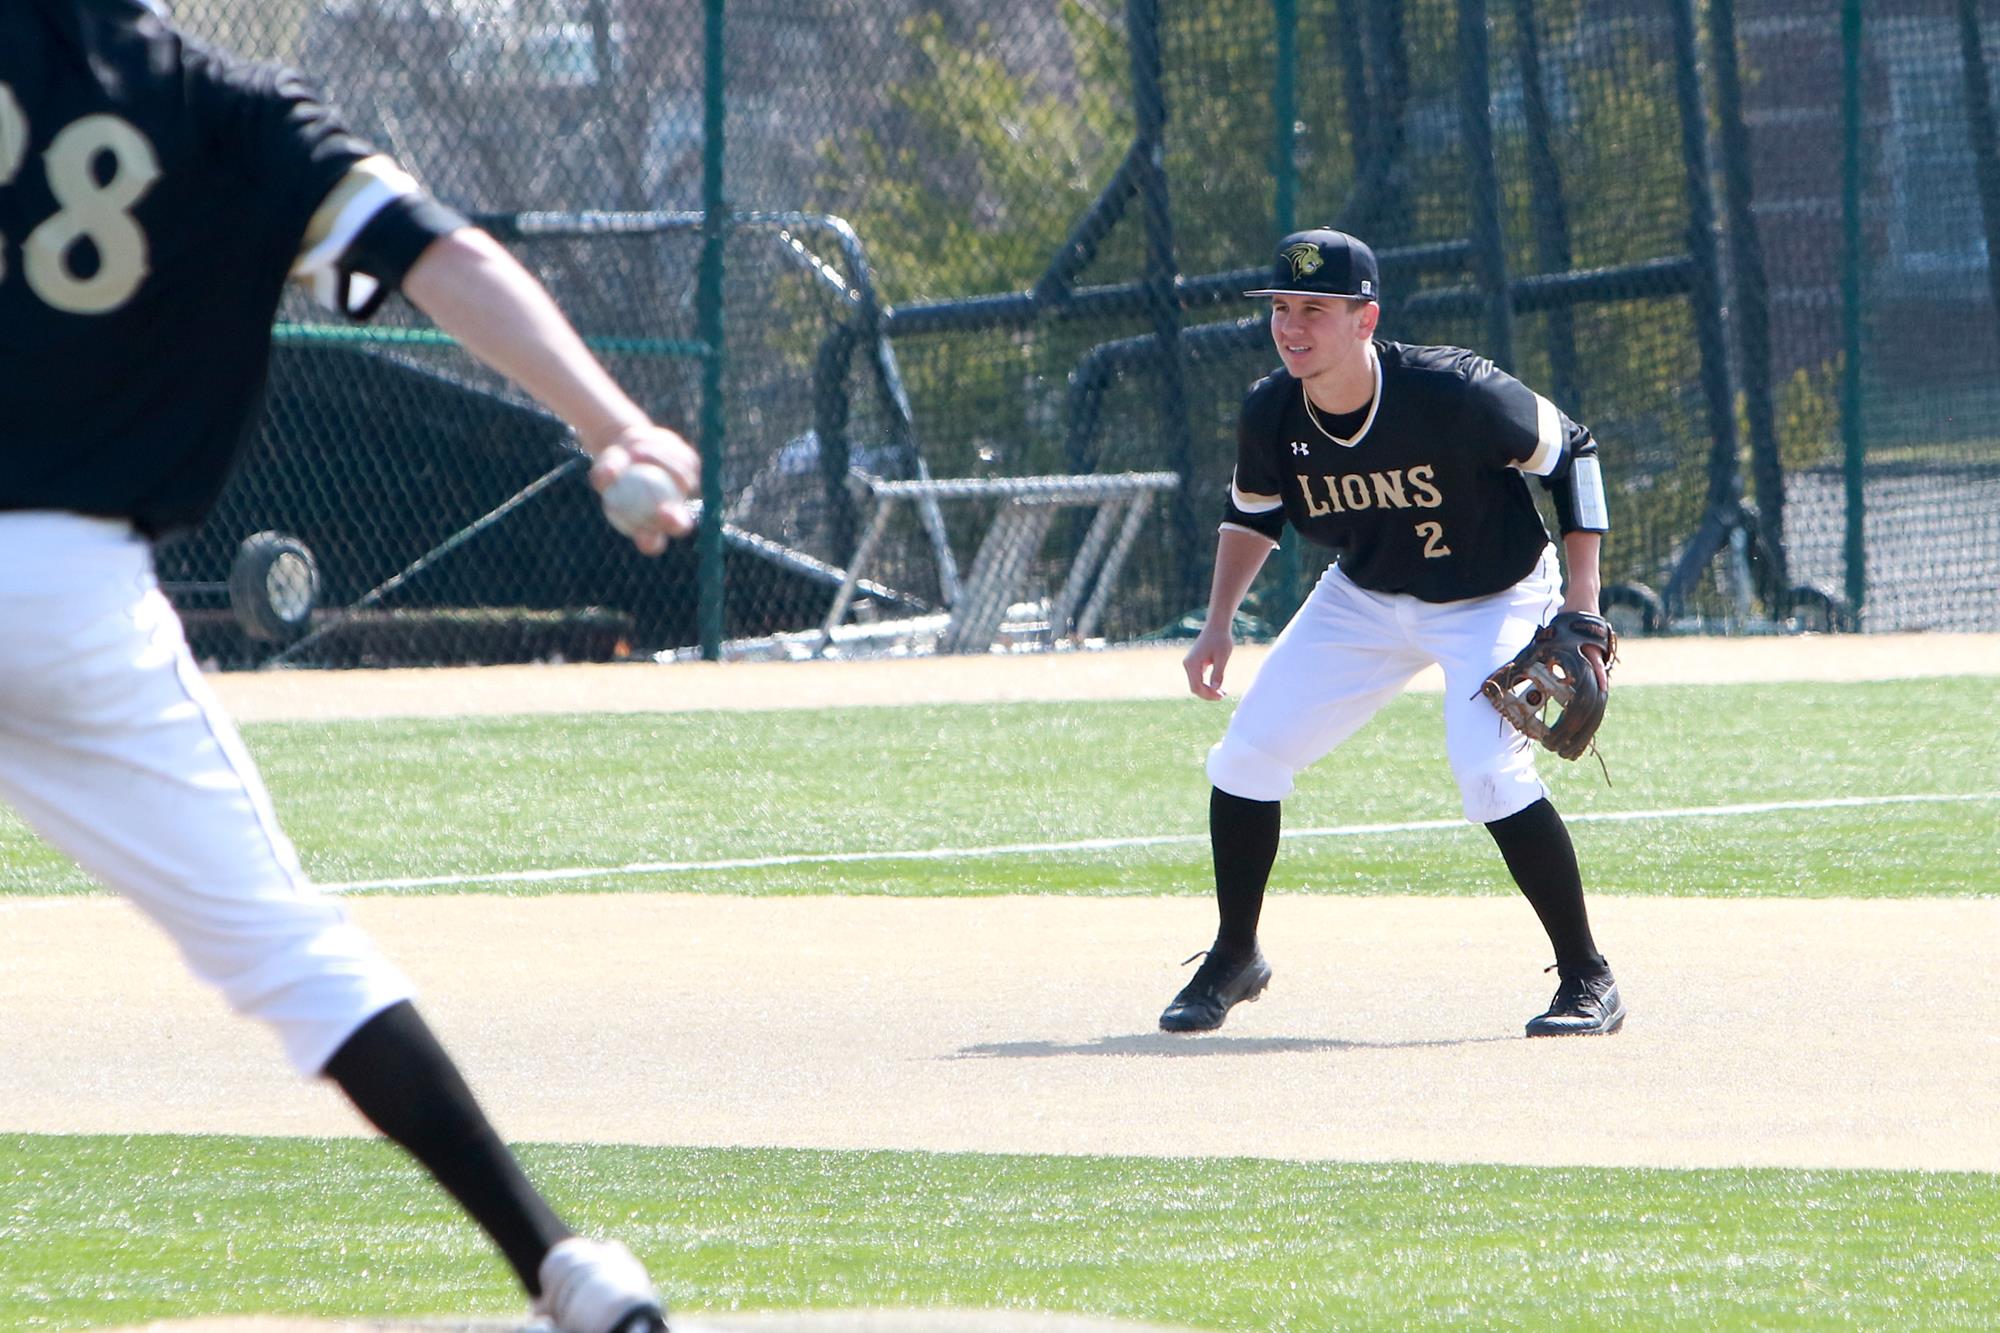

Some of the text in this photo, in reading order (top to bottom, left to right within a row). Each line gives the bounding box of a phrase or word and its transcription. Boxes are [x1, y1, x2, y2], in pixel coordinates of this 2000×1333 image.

[0, 79, 162, 315] 8
[1297, 464, 1443, 518] LIONS
[1415, 521, 1451, 559] 2
